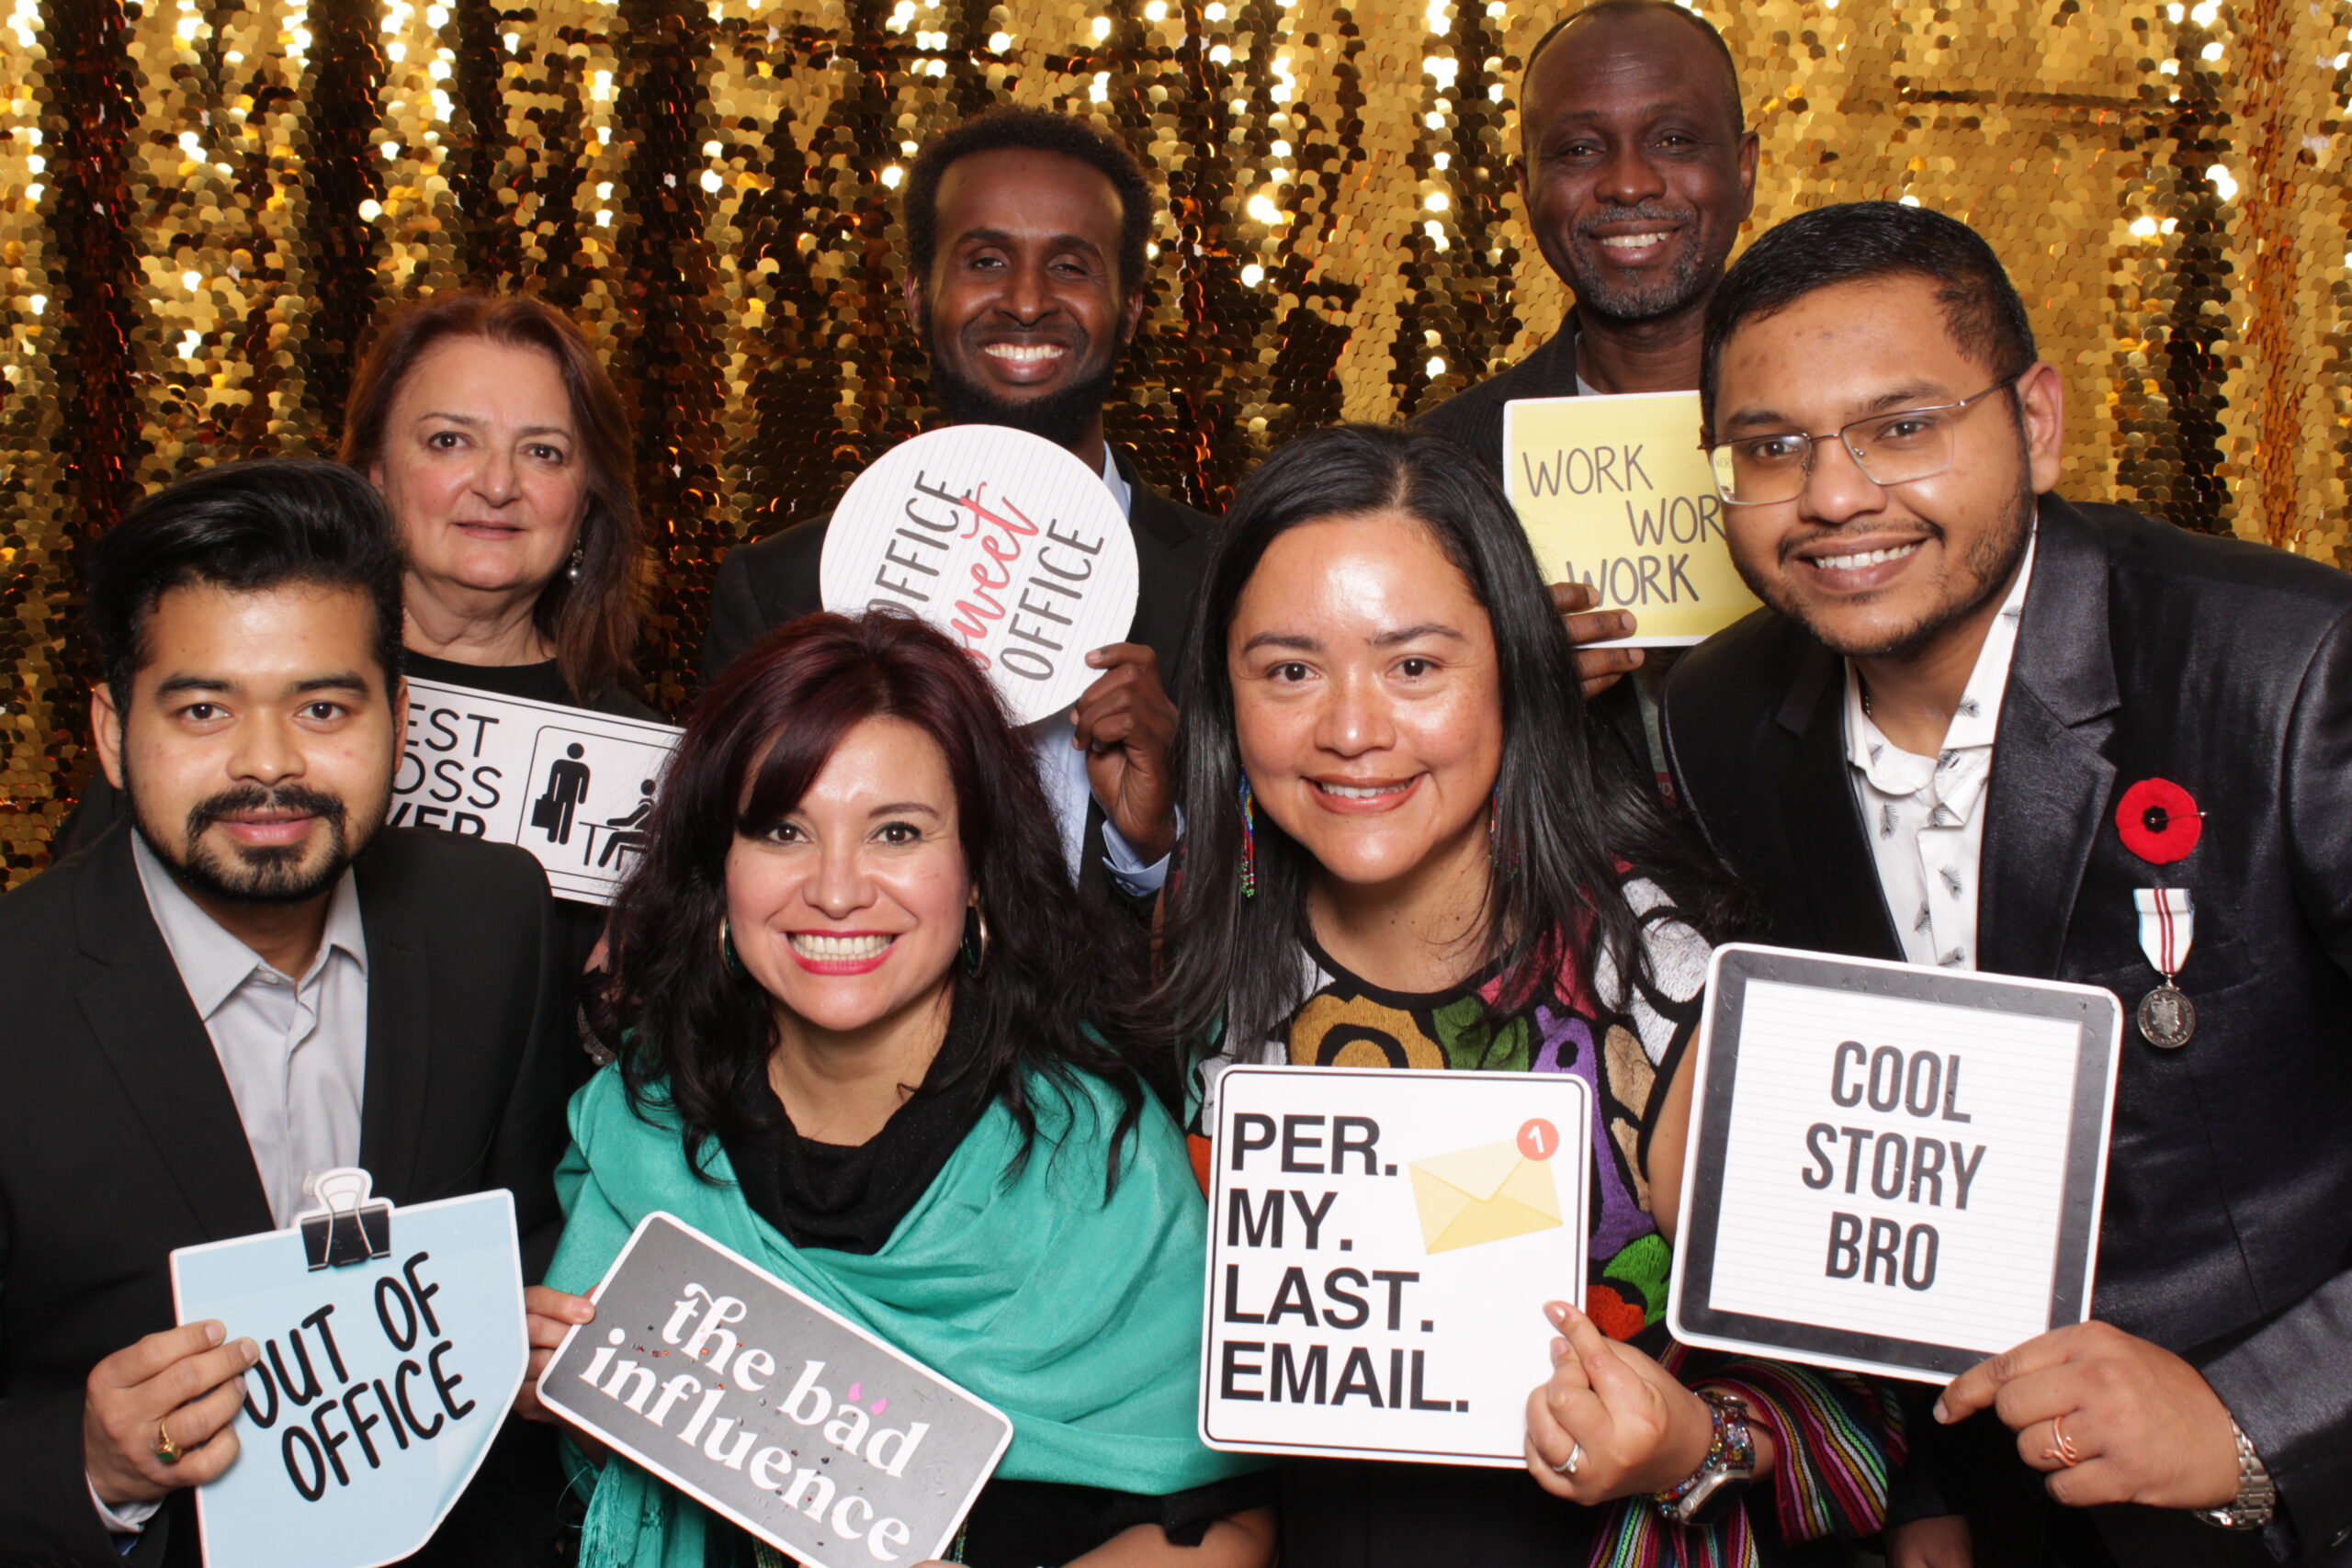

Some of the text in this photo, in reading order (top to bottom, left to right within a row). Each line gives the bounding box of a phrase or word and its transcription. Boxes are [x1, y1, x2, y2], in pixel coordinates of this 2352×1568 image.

[1521, 445, 1654, 497] WORK
[1625, 493, 1728, 547] WOR
[999, 518, 1104, 682] OFFICE
[1565, 552, 1701, 608] WORK
[405, 702, 501, 759] EST
[390, 750, 503, 809] OSS
[1830, 1040, 1972, 1124] COOL
[1230, 1111, 1398, 1178] PER.
[1528, 1125, 1544, 1154] 1
[1801, 1122, 1987, 1211] STORY
[1227, 1187, 1353, 1252] MY.
[1825, 1211, 1940, 1292] BRO
[1223, 1263, 1434, 1333] LAST.
[242, 1251, 440, 1429] OUT OF
[661, 1281, 931, 1479] the bad
[1220, 1339, 1470, 1414] EMAIL.
[281, 1339, 477, 1503] OFFICE
[578, 1326, 910, 1562] influence
